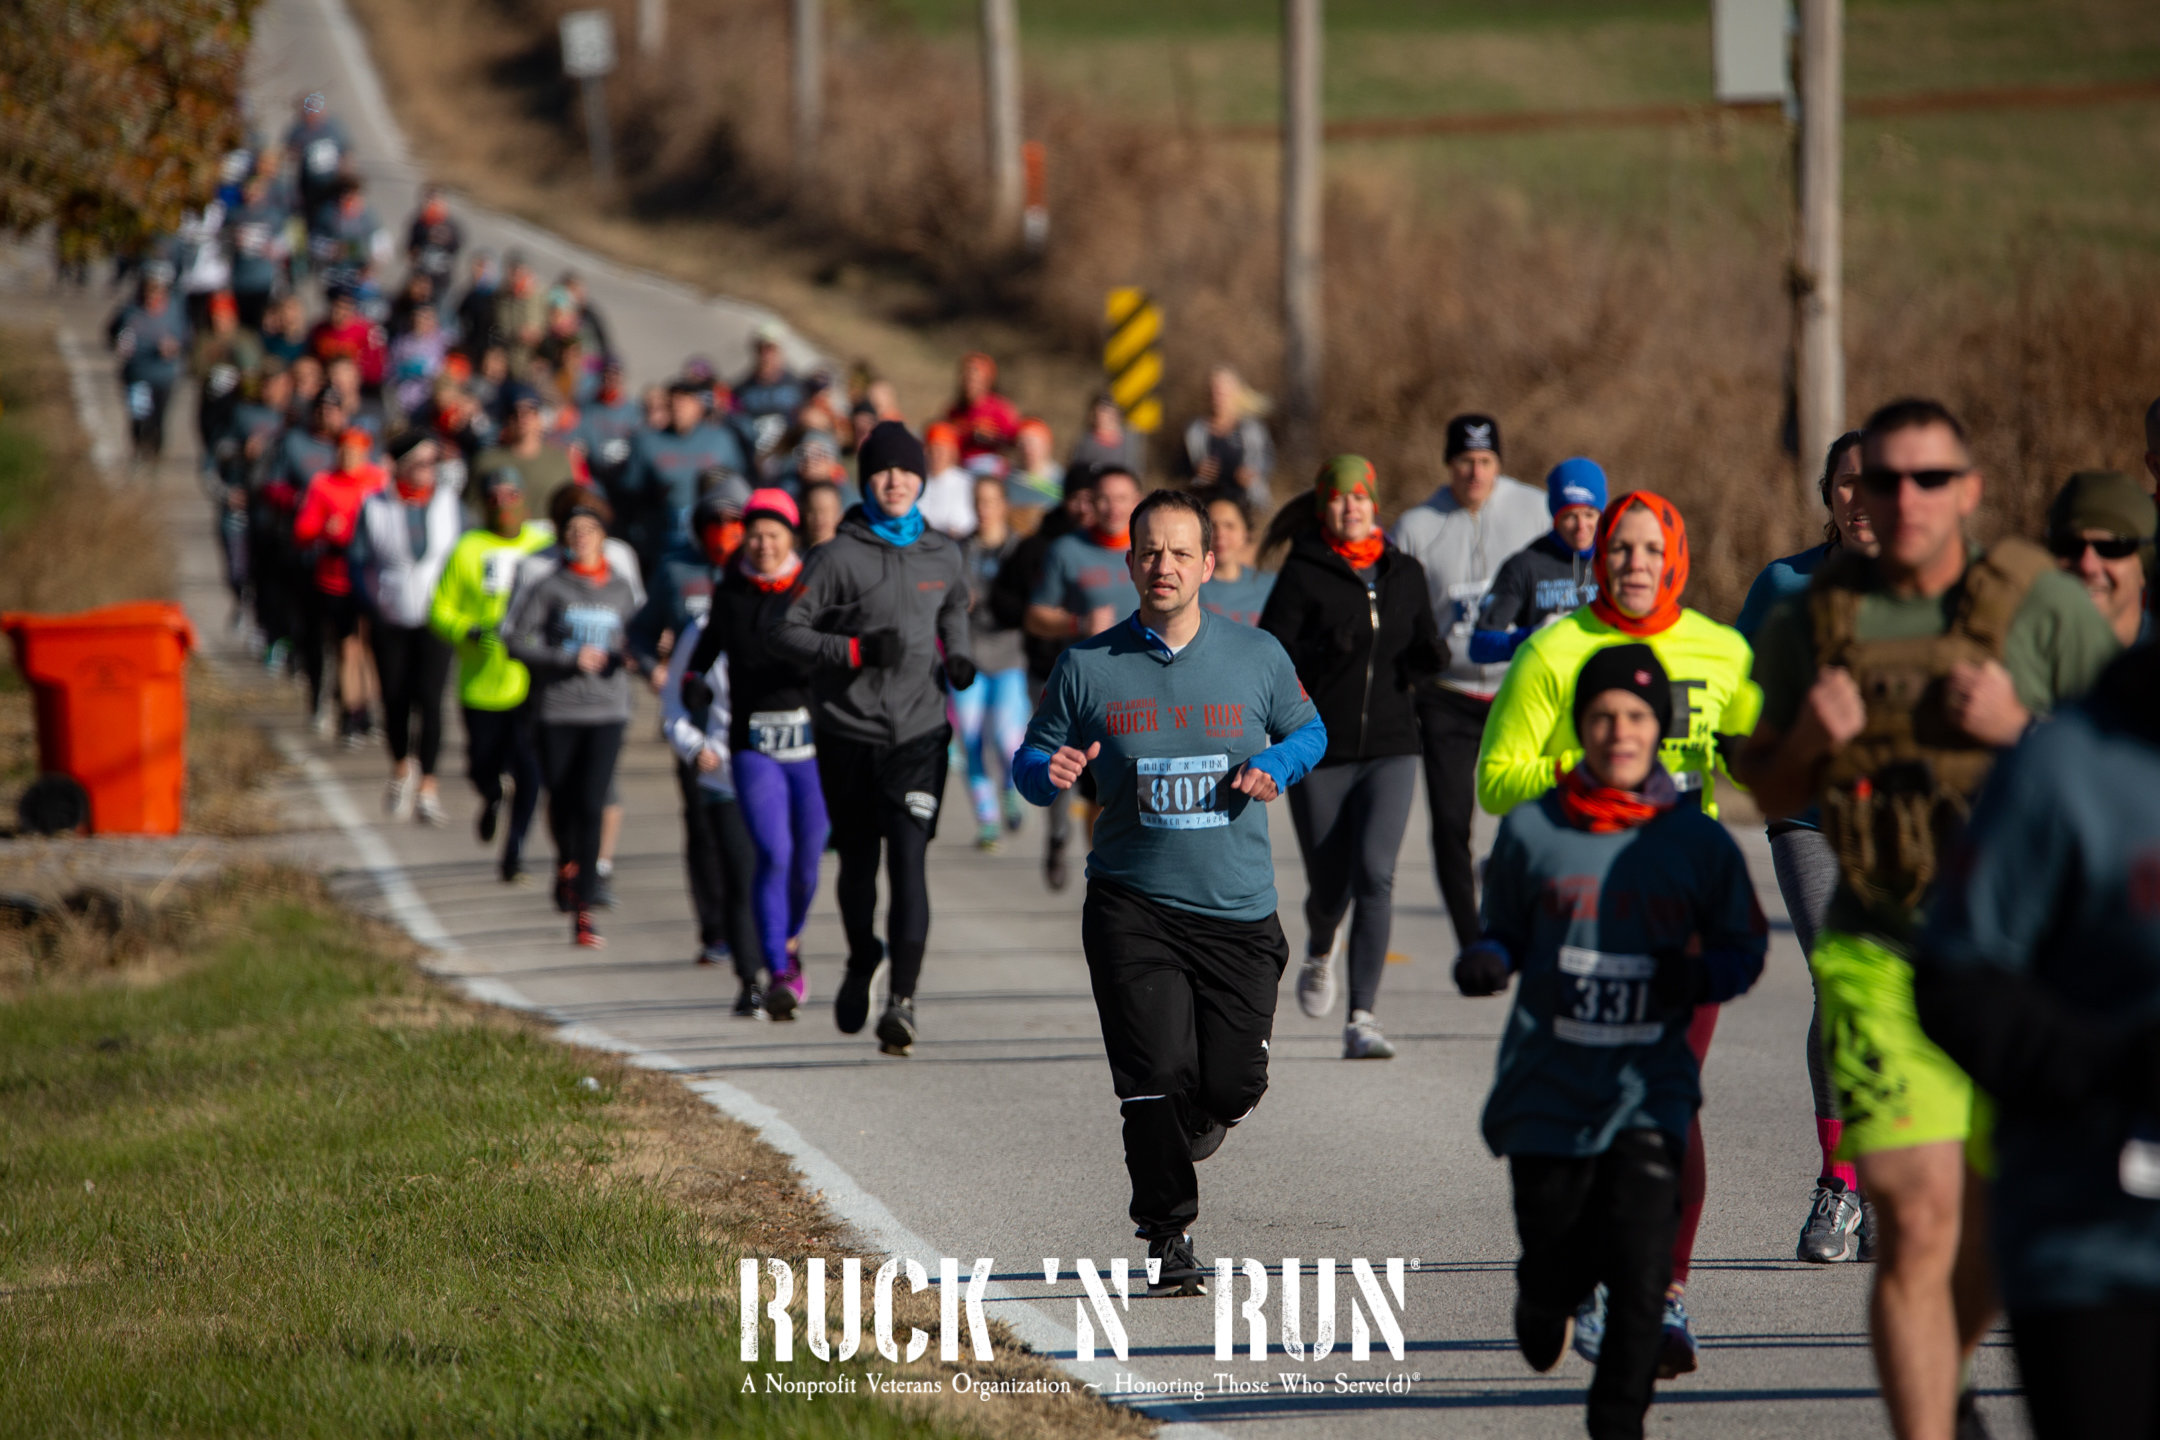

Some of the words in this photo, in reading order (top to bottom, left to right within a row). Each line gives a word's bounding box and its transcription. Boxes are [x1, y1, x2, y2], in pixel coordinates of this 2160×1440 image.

[1106, 708, 1159, 737] RUCK
[1168, 704, 1193, 729] 'N'
[1203, 703, 1243, 728] RUN
[759, 724, 803, 751] 371
[1143, 762, 1172, 772] RUCK
[1178, 761, 1195, 770] 'N'
[1201, 759, 1222, 769] RUN
[1151, 775, 1217, 812] 800
